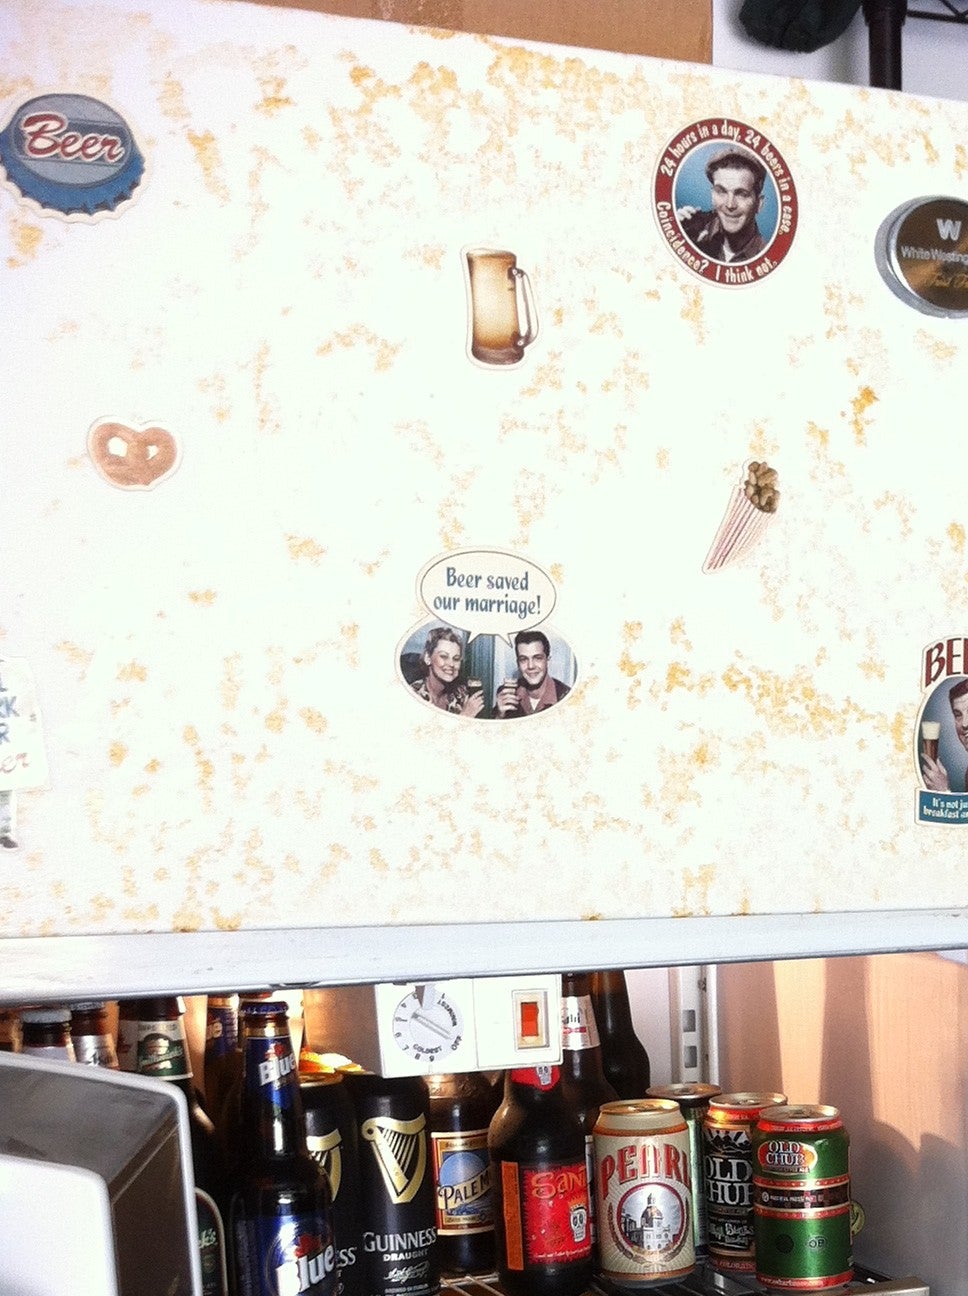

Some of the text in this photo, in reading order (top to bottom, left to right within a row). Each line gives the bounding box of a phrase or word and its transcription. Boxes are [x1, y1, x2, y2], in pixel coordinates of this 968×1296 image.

[22, 113, 124, 162] Beer
[697, 123, 709, 139] in
[711, 124, 720, 136] a
[745, 129, 762, 149] 24
[668, 132, 698, 158] hours
[661, 157, 685, 177] 24
[761, 143, 785, 177] beers
[780, 176, 792, 192] in
[656, 201, 710, 276] Coincidence?
[715, 263, 721, 281] I
[724, 264, 754, 283] think
[446, 566, 529, 591] Beer saved
[433, 593, 541, 620] our marriage!
[923, 805, 959, 819] breakfast
[946, 797, 958, 809] not
[413, 1043, 442, 1054] COLDEST
[768, 1140, 800, 1155] OLD
[766, 1153, 806, 1165] CHUB
[362, 1227, 438, 1253] GUINNESS
[383, 1248, 428, 1262] DRAUGHT
